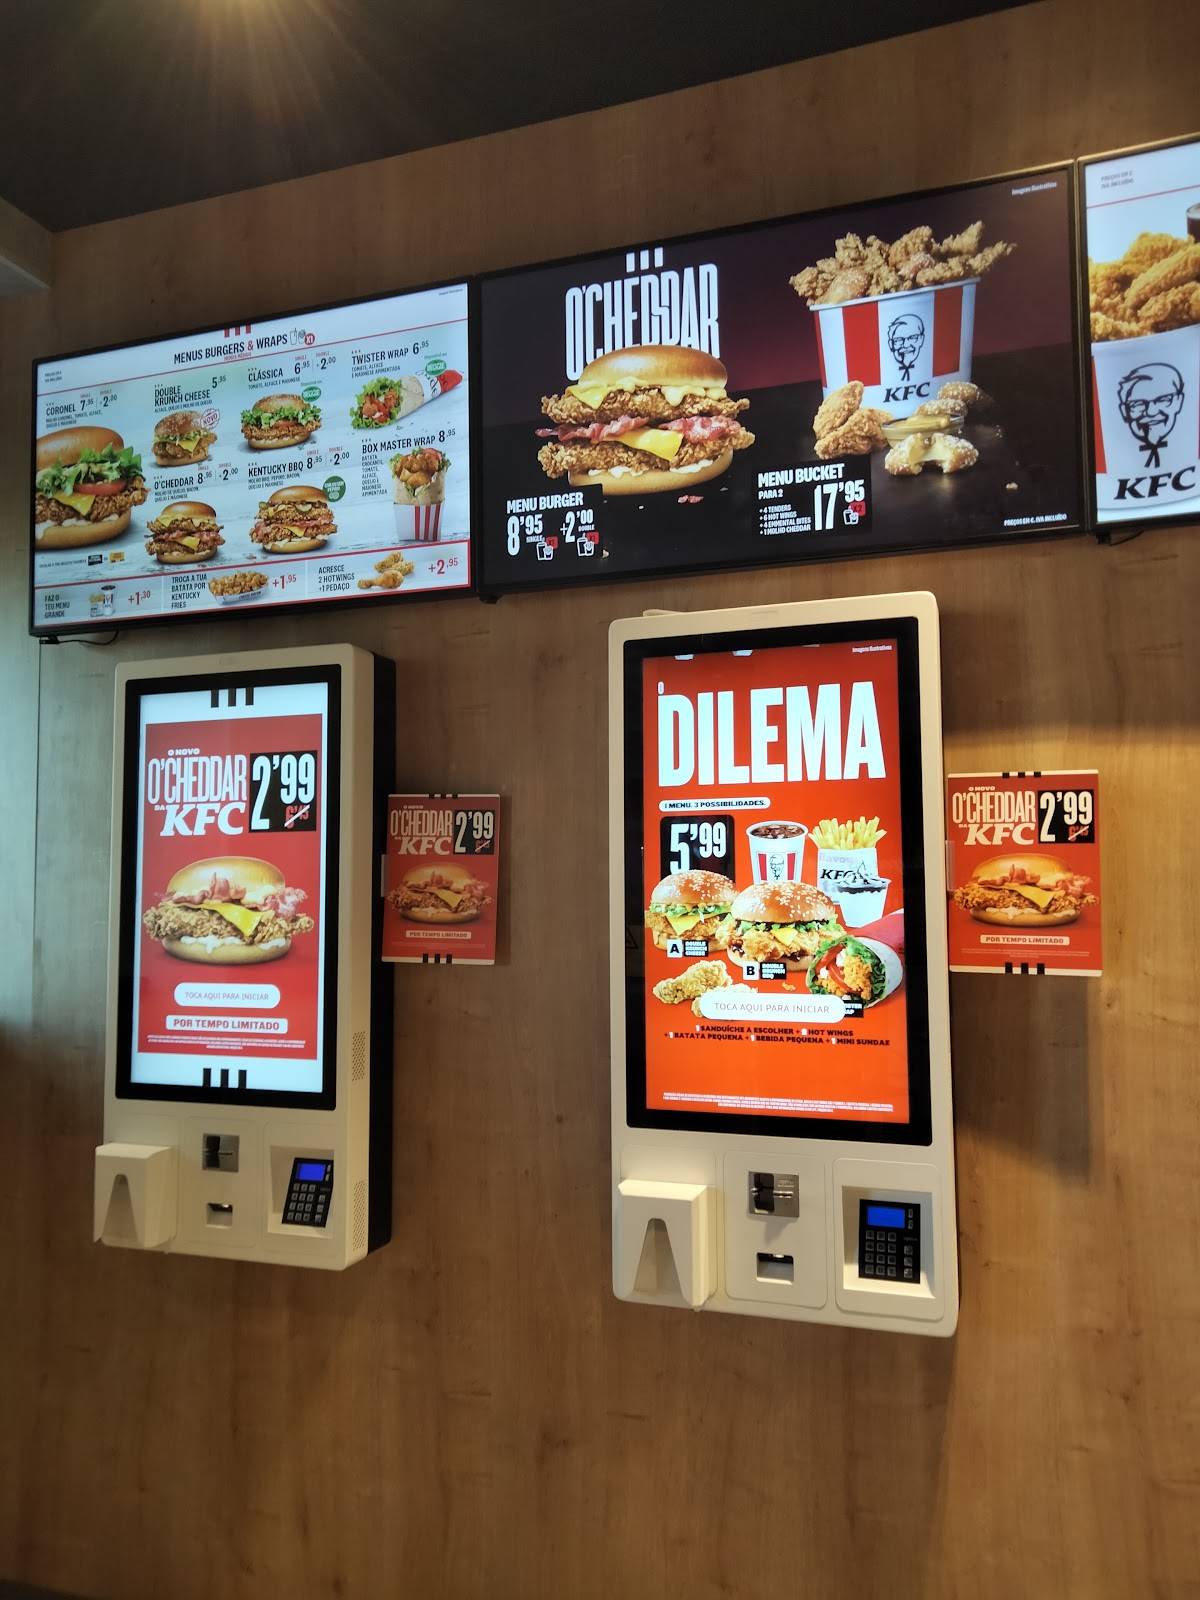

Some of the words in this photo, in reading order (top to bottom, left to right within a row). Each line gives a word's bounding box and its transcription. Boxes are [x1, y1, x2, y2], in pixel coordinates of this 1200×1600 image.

[565, 263, 720, 381] O'CHEDDAR
[174, 349, 203, 365] MENUS
[205, 341, 245, 359] BURGERS
[247, 340, 254, 351] &
[256, 333, 288, 349] WRAPS
[351, 351, 386, 366] TWISTER
[388, 347, 409, 360] WRAP
[248, 367, 284, 382] CLÁSSICA
[154, 385, 181, 398] DOUBLE
[154, 394, 183, 407] KRUNCH
[184, 389, 210, 401] CHEESE
[883, 382, 931, 403] KFC
[46, 403, 76, 417] CORONEL
[362, 443, 378, 454] BOX
[380, 440, 412, 452] MASTER
[413, 436, 436, 448] WRAP
[248, 463, 287, 478] KENTUCKY
[288, 461, 304, 473] BBQ
[758, 469, 794, 488] MENU
[795, 463, 845, 484] BUCKET
[154, 476, 194, 490] O'CHEDDAR
[1113, 466, 1196, 500] KFC
[506, 496, 538, 514] MENU
[539, 491, 584, 510] BURGER
[758, 490, 777, 500] PARA
[778, 488, 784, 498] 2
[814, 480, 865, 531] 17'95
[768, 518, 795, 528] EMMENTAL
[786, 524, 811, 533] CHEDDAR
[507, 514, 544, 556] 8'95
[318, 565, 344, 574] ACRESCE
[428, 558, 458, 575] +2,95
[172, 575, 190, 583] TROCA
[172, 584, 192, 592] BATATA
[194, 582, 205, 590] POR
[172, 591, 200, 600] KENTUCKY
[172, 601, 186, 609] FRIES
[657, 681, 664, 695] O
[658, 680, 886, 787] DILEMA
[168, 748, 174, 756] O
[175, 747, 200, 756] NOVO
[147, 754, 247, 804] O'CHEDDAR
[250, 753, 315, 831] 2'99
[952, 790, 1036, 824] O'CHEDDAR
[160, 802, 246, 836] KFC
[390, 810, 453, 837] O'CHEDDAR
[1039, 791, 1093, 842] 2'99
[454, 811, 494, 854] 2'99
[964, 822, 1036, 846] KFC
[398, 836, 452, 856] KFC
[670, 822, 726, 875] 5'99
[670, 944, 680, 954] A
[746, 966, 755, 976] B
[203, 992, 220, 1000] AQUI
[241, 993, 269, 1001] INICIAR
[714, 1002, 738, 1011] TOCA
[740, 1003, 763, 1013] AQUI
[766, 1004, 789, 1012] PARA
[791, 1005, 830, 1014] INICIAR
[173, 1019, 193, 1028] POR
[195, 1020, 229, 1030] TEMPO
[232, 1021, 279, 1031] LIMITADO
[700, 1024, 744, 1032] SANDUÍCHE
